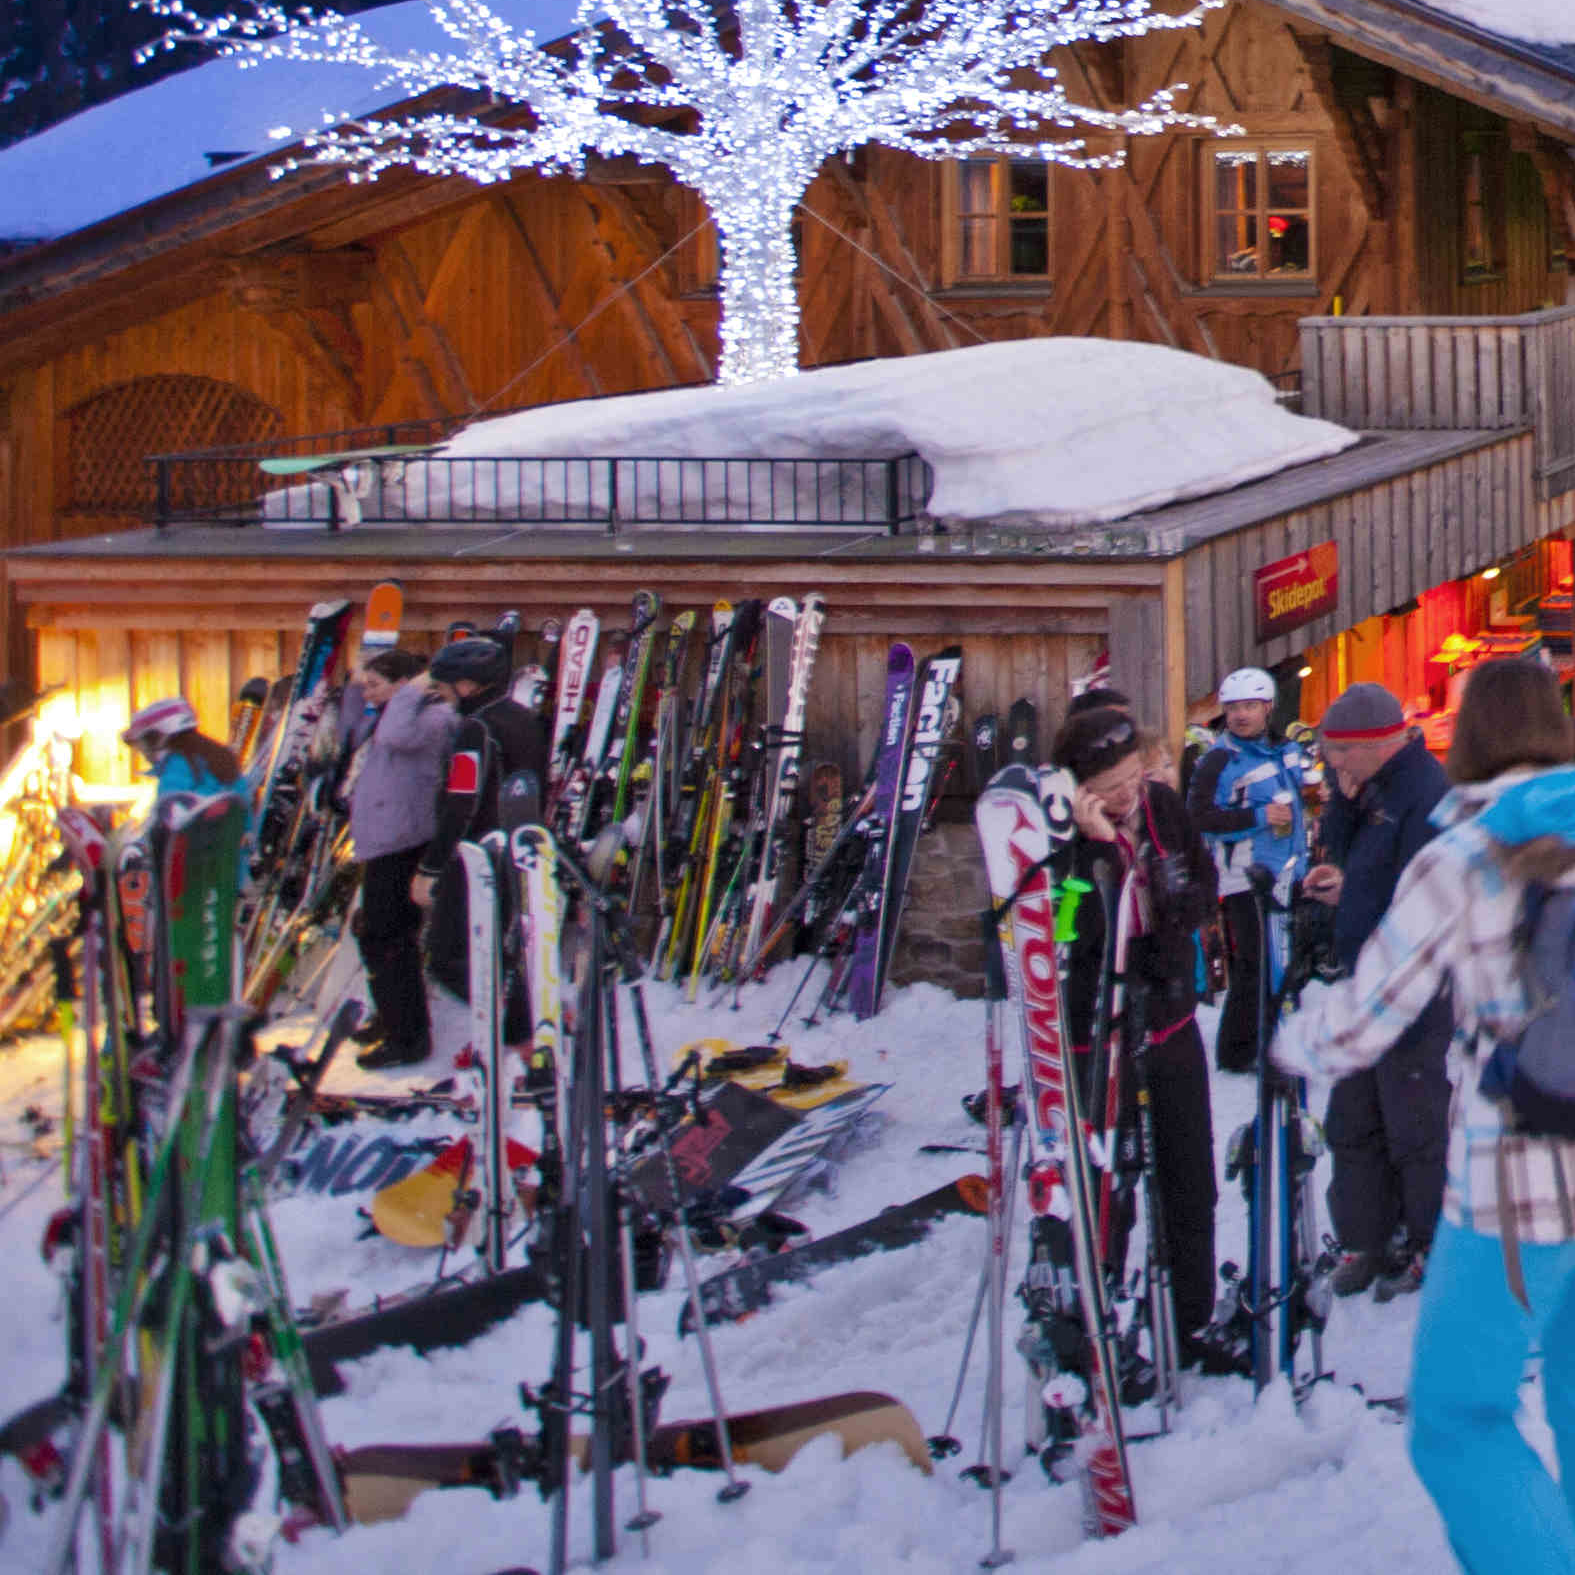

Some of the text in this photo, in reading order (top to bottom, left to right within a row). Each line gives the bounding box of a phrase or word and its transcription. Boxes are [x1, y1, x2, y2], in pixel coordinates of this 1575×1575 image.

[1268, 577, 1326, 619] Skidepot
[562, 625, 590, 713] HEAD
[1009, 839, 1068, 1130] ATOMIC
